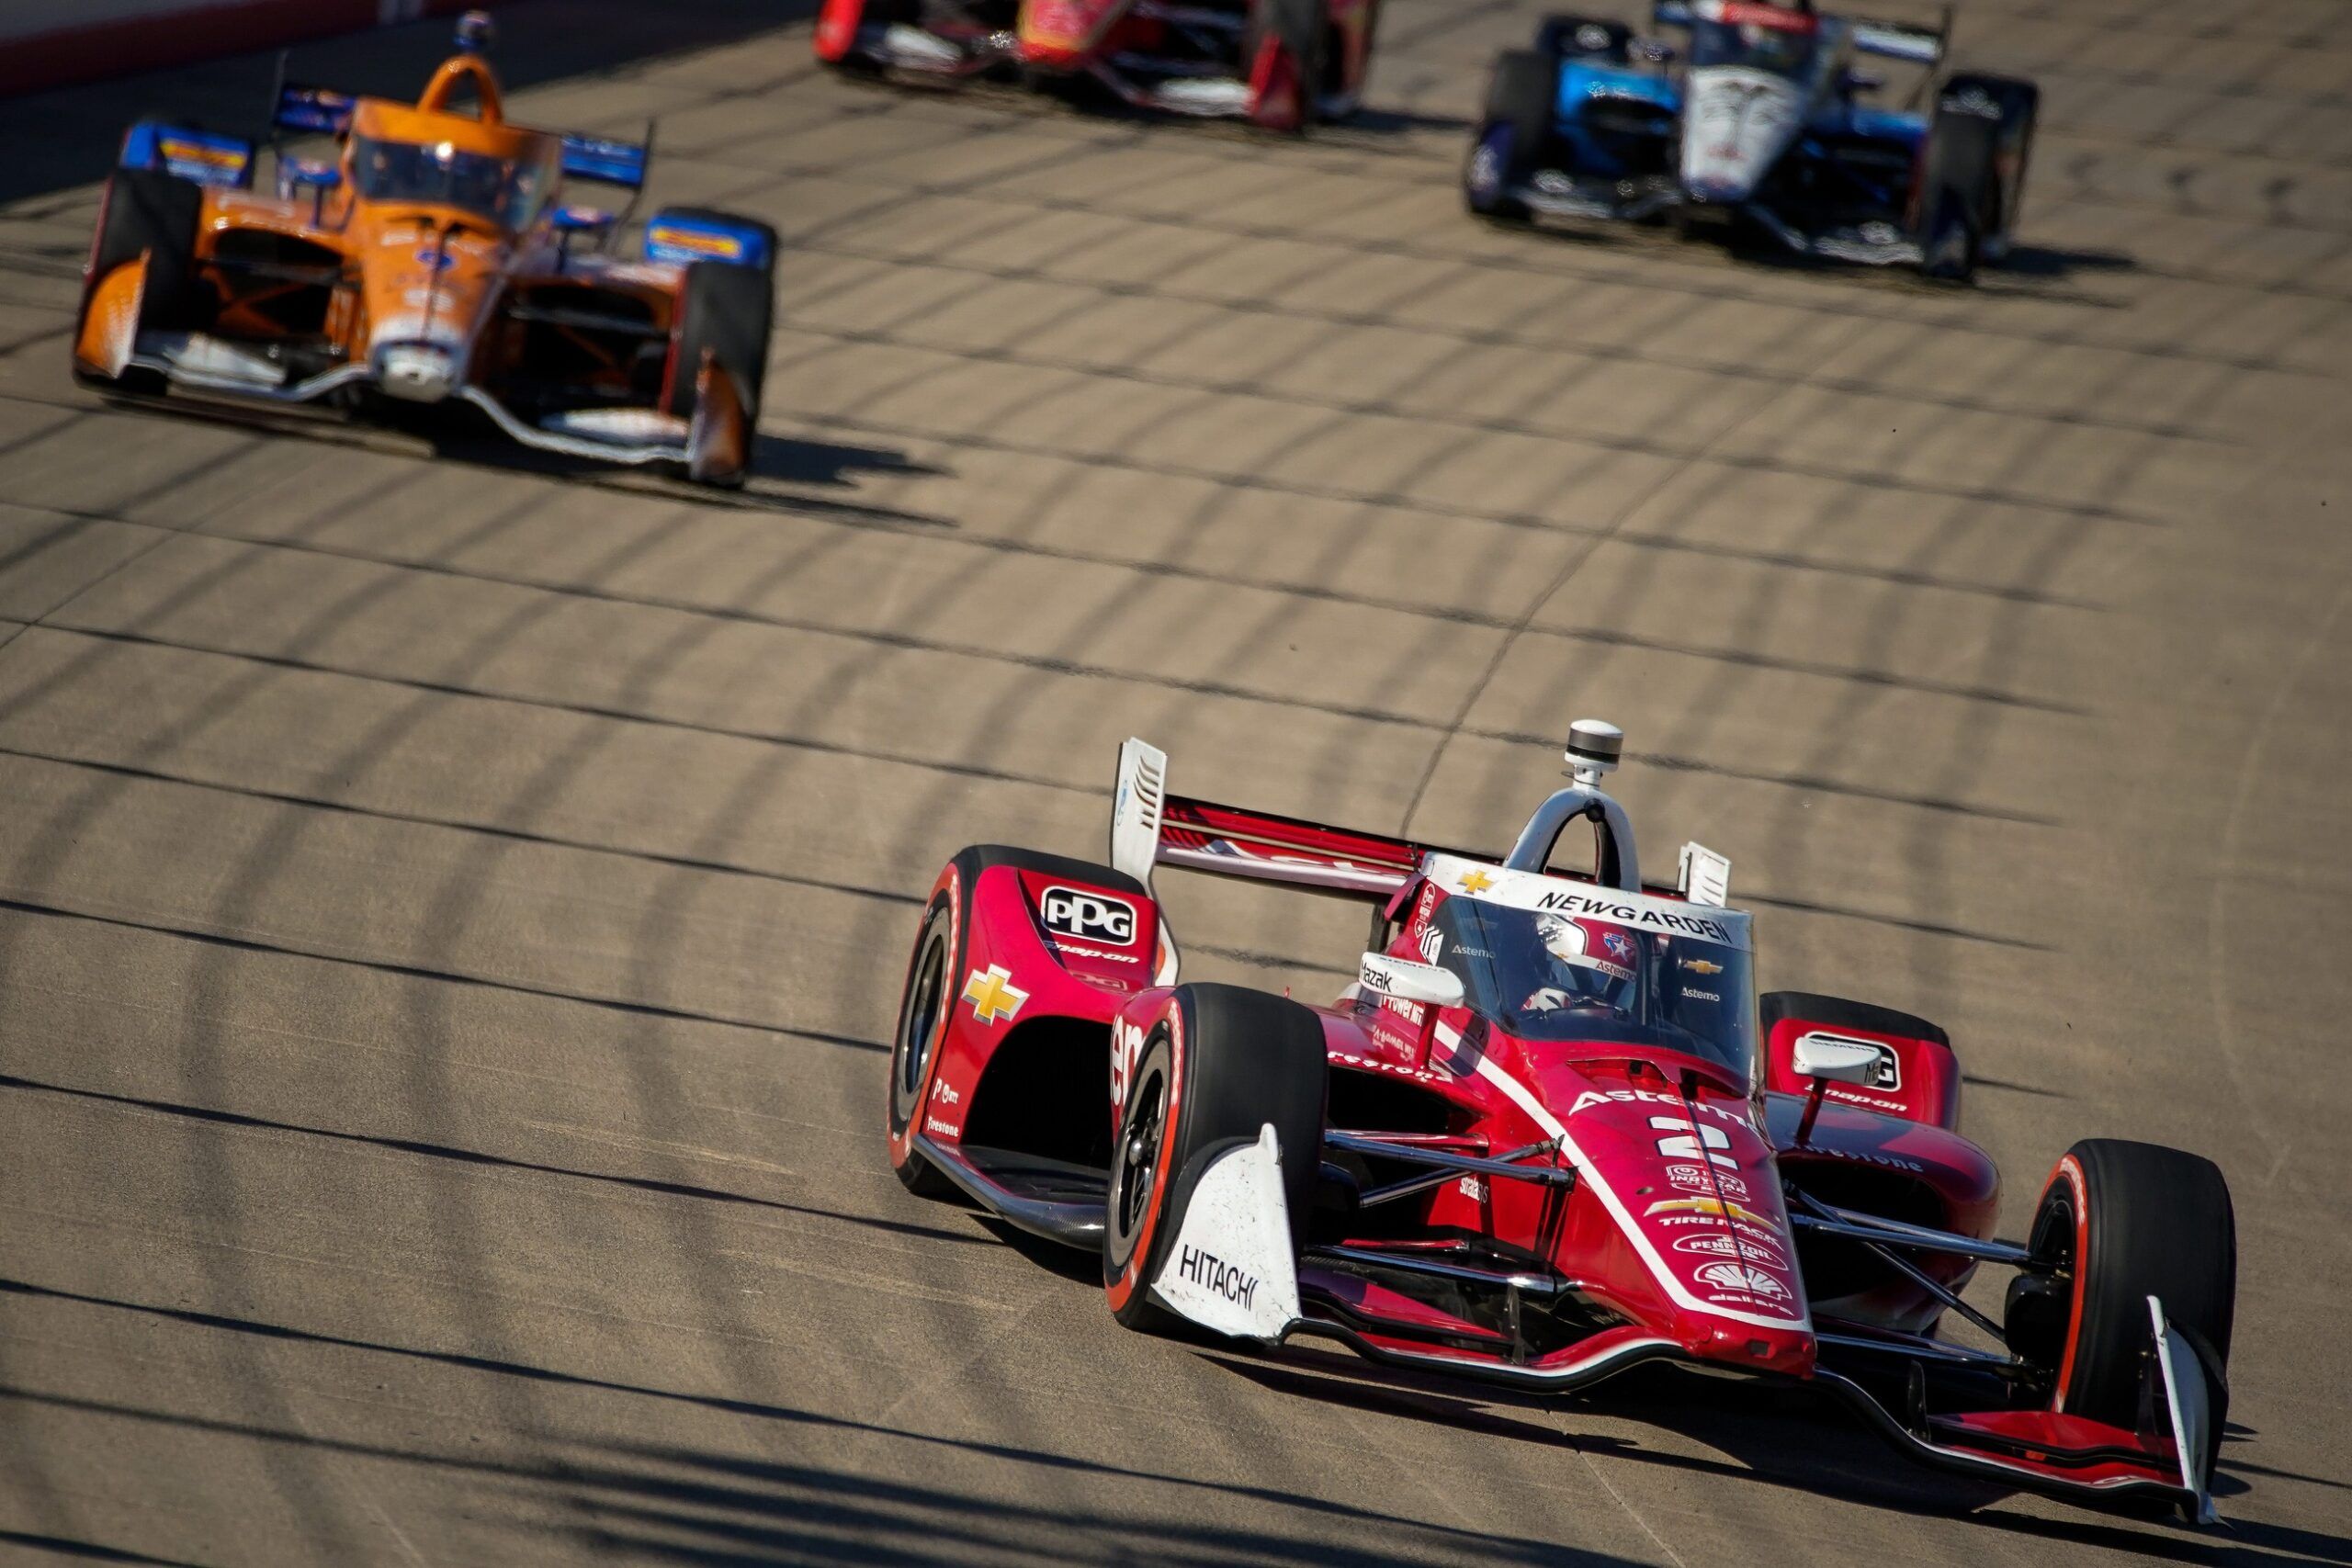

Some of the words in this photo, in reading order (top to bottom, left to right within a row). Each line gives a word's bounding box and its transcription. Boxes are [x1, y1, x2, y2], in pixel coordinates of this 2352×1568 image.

[1047, 897, 1131, 938] PPG
[1537, 892, 1733, 944] NEWGARDEN
[1452, 944, 1497, 959] Astemo
[1596, 961, 1637, 984] Astemo
[1682, 987, 1721, 1003] Astemo
[1328, 1051, 1453, 1083] restone
[927, 1115, 959, 1137] Firestone
[1648, 1116, 1739, 1171] 2
[1690, 1240, 1772, 1260] PENNZOIL
[1180, 1244, 1259, 1312] HITACHI
